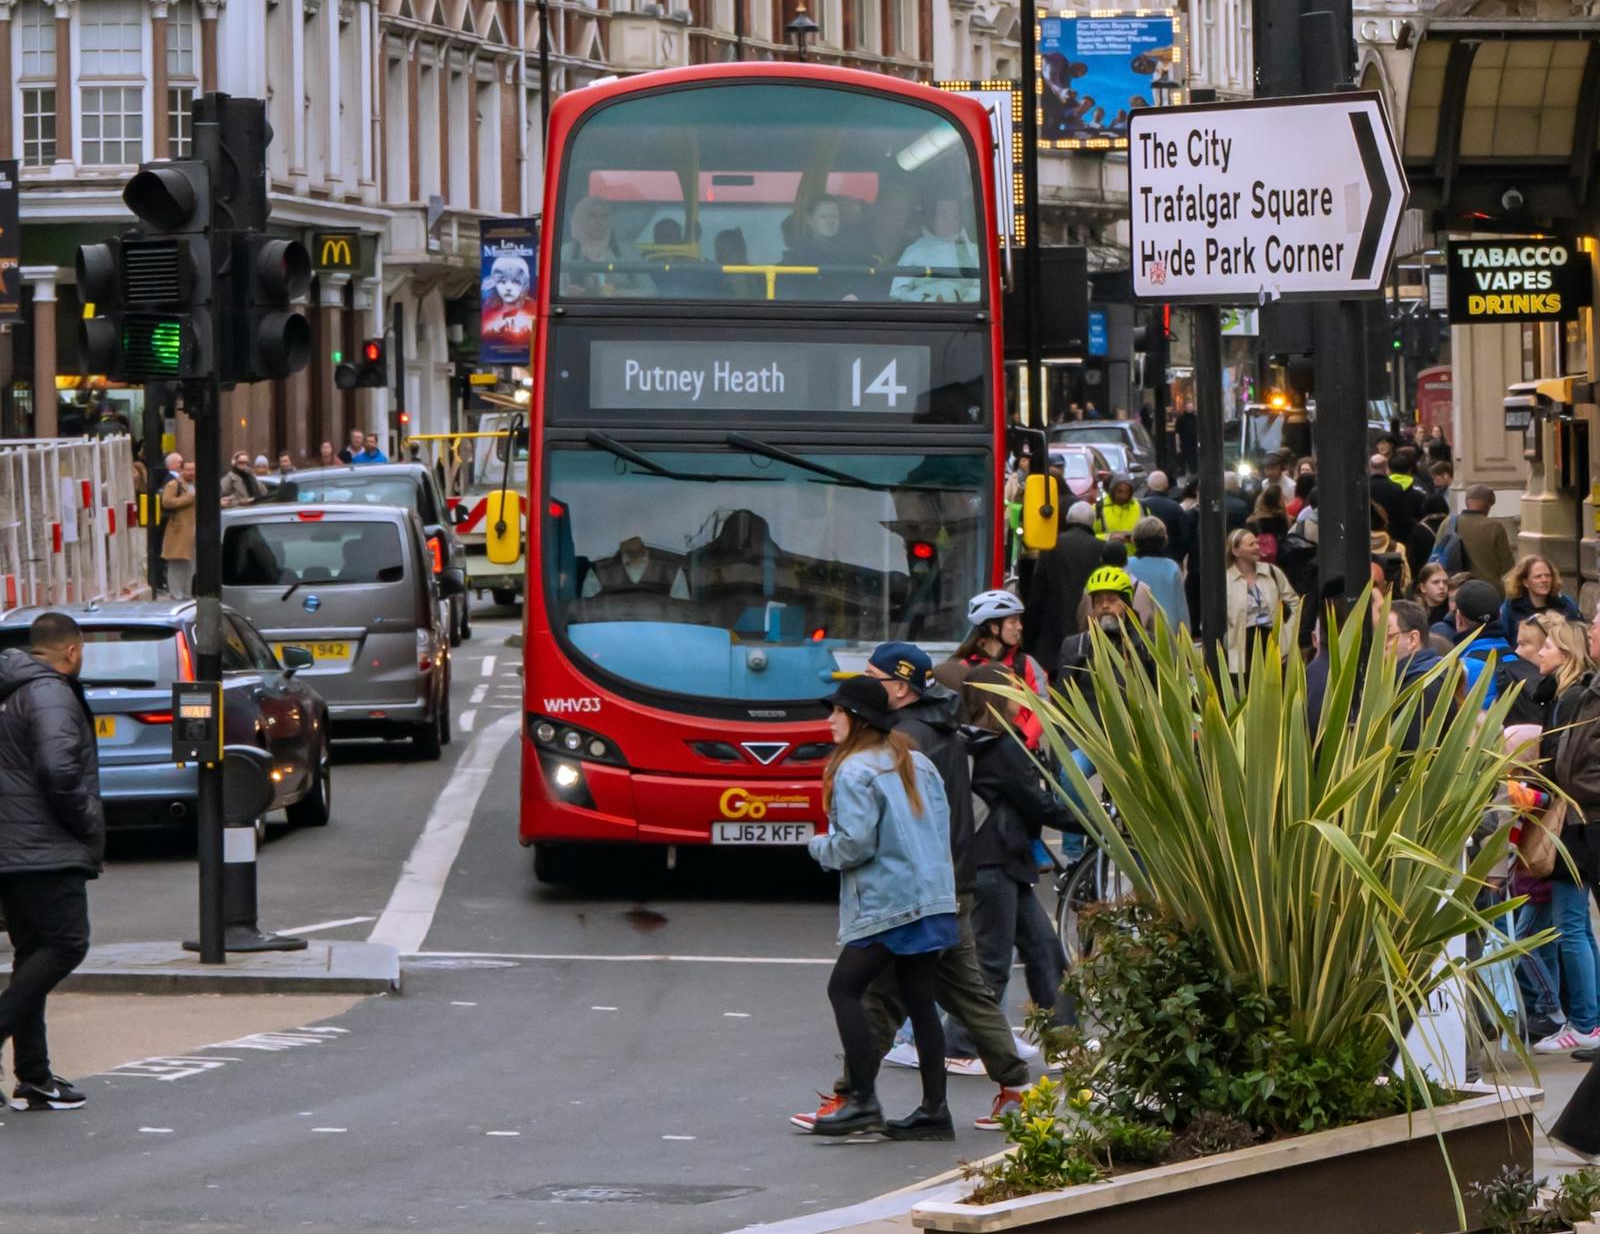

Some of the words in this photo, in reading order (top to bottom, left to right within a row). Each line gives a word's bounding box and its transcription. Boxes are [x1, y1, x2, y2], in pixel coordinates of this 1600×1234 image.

[1139, 132, 1178, 169] The
[1187, 129, 1232, 173] City
[1140, 183, 1241, 229] Trafalgar
[1251, 180, 1333, 225] Square
[1141, 239, 1196, 278] Hyde
[1205, 237, 1256, 275] Park
[1265, 235, 1344, 274] Corner
[1457, 246, 1568, 268] TABACCO
[1475, 271, 1553, 291] VAPES
[1468, 293, 1562, 315] DRINKS
[625, 359, 704, 401] Putney
[714, 361, 785, 392] Heath
[852, 358, 907, 407] 14
[543, 697, 601, 713] WHV33
[720, 825, 767, 842] LJ62
[772, 825, 806, 842] KFF
